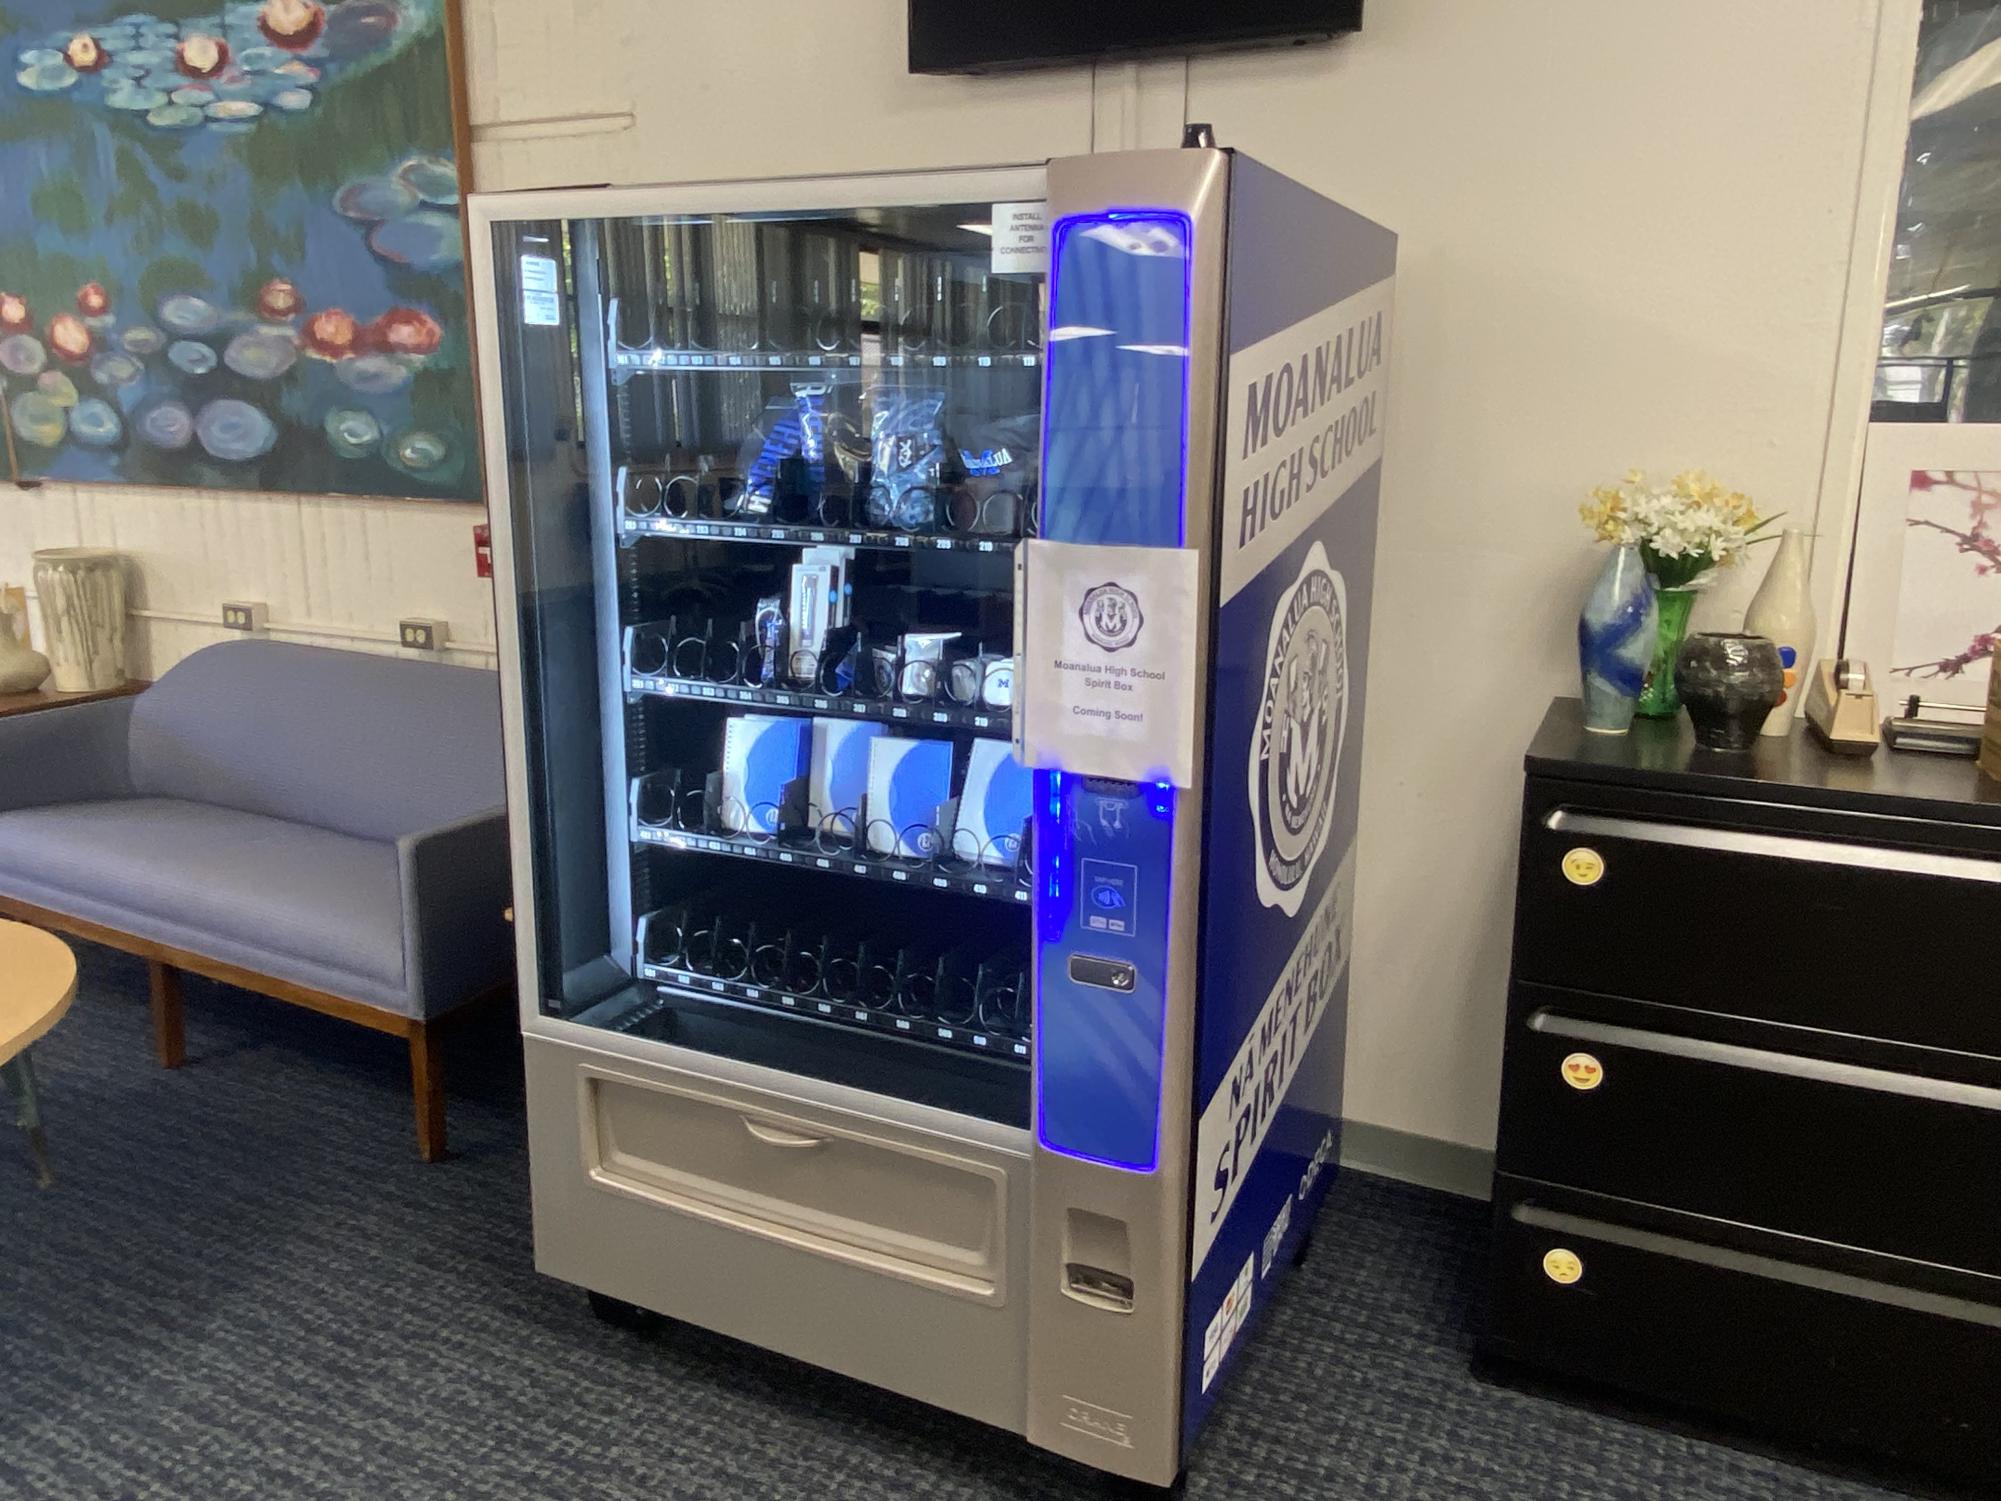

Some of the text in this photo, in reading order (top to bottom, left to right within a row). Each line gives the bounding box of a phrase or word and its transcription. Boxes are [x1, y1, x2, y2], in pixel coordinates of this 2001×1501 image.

[1018, 235, 1034, 243] FOR
[1242, 310, 1383, 460] MOANALUA
[1239, 390, 1377, 549] HIGH SCHOOL
[1054, 660, 1165, 680] Moanalua High School
[1084, 677, 1133, 691] Spirit Box
[1072, 705, 1143, 722] Coming Soon!
[1209, 1002, 1303, 1225] SPIRIT
